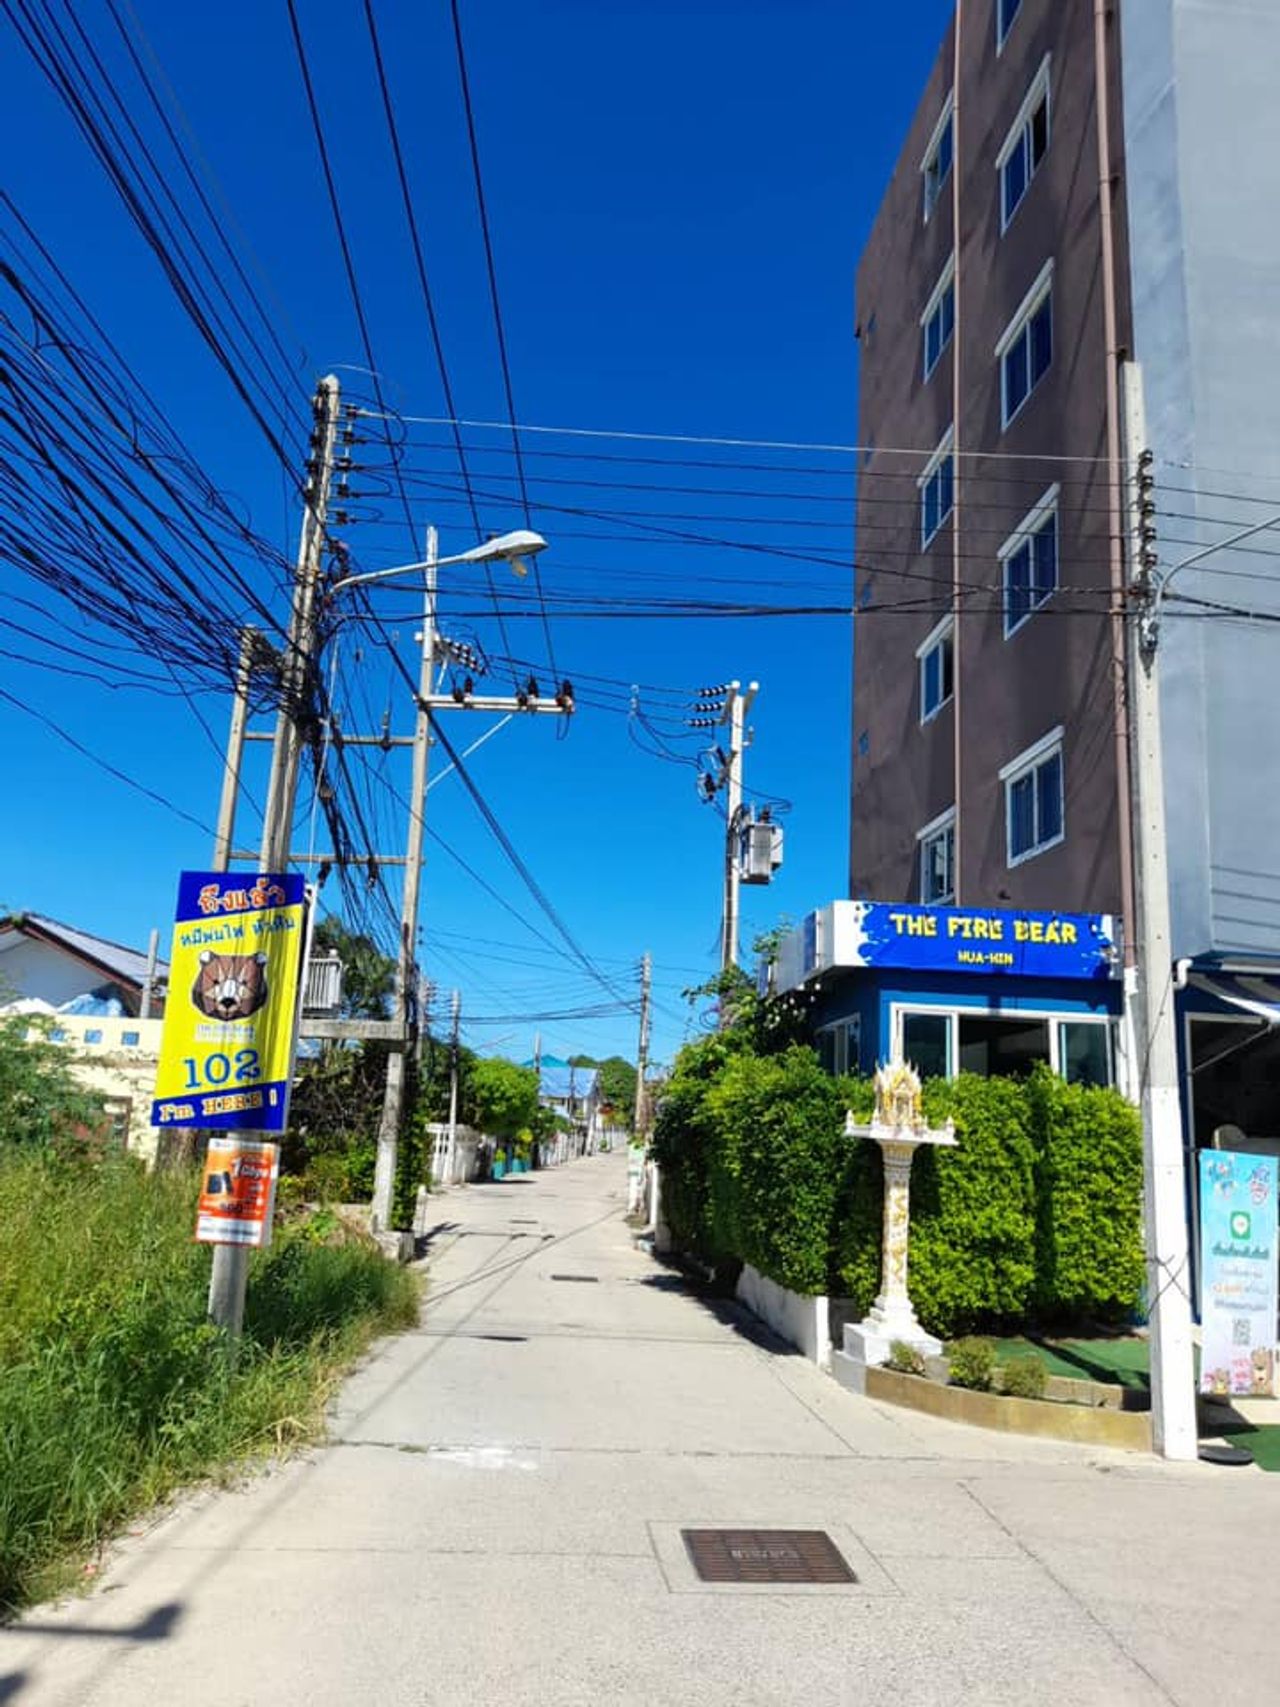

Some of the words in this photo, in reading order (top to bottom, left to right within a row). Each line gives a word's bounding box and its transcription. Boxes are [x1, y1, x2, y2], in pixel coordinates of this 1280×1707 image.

[889, 914, 937, 936] THE
[948, 917, 1003, 940] FIRE
[1014, 920, 1077, 944] BEAR
[958, 950, 1013, 966] HUA-HIN
[183, 1049, 261, 1088] 102
[201, 1091, 262, 1116] HERE
